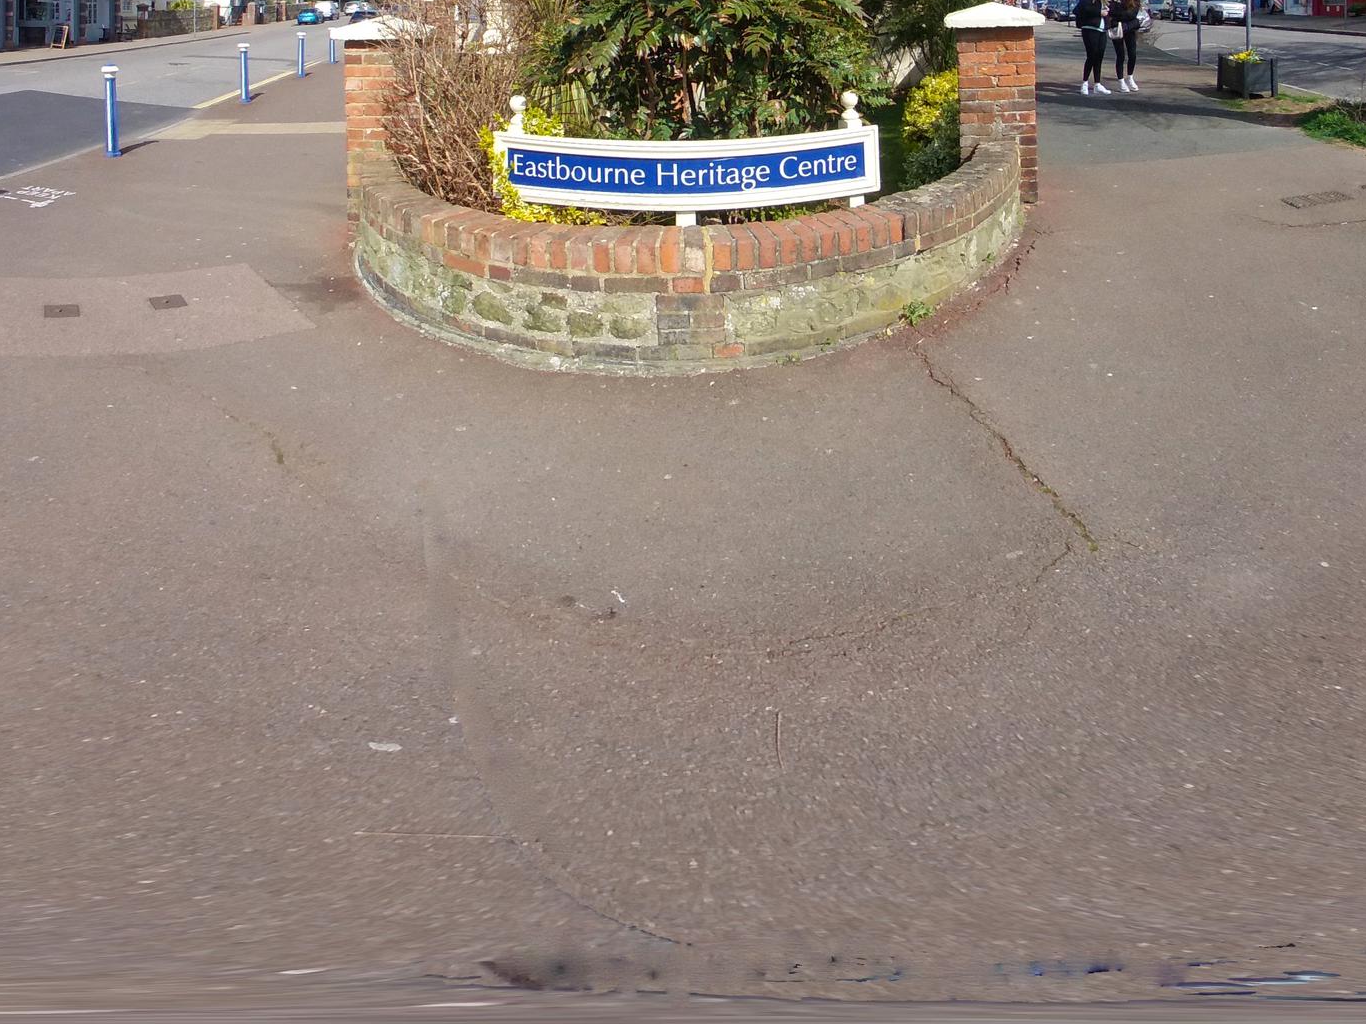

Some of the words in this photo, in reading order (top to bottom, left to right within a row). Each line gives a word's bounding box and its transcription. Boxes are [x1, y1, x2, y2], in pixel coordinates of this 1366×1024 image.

[513, 154, 646, 185] Eastbourne
[657, 162, 771, 192] Heritage
[779, 151, 857, 180] Centre
